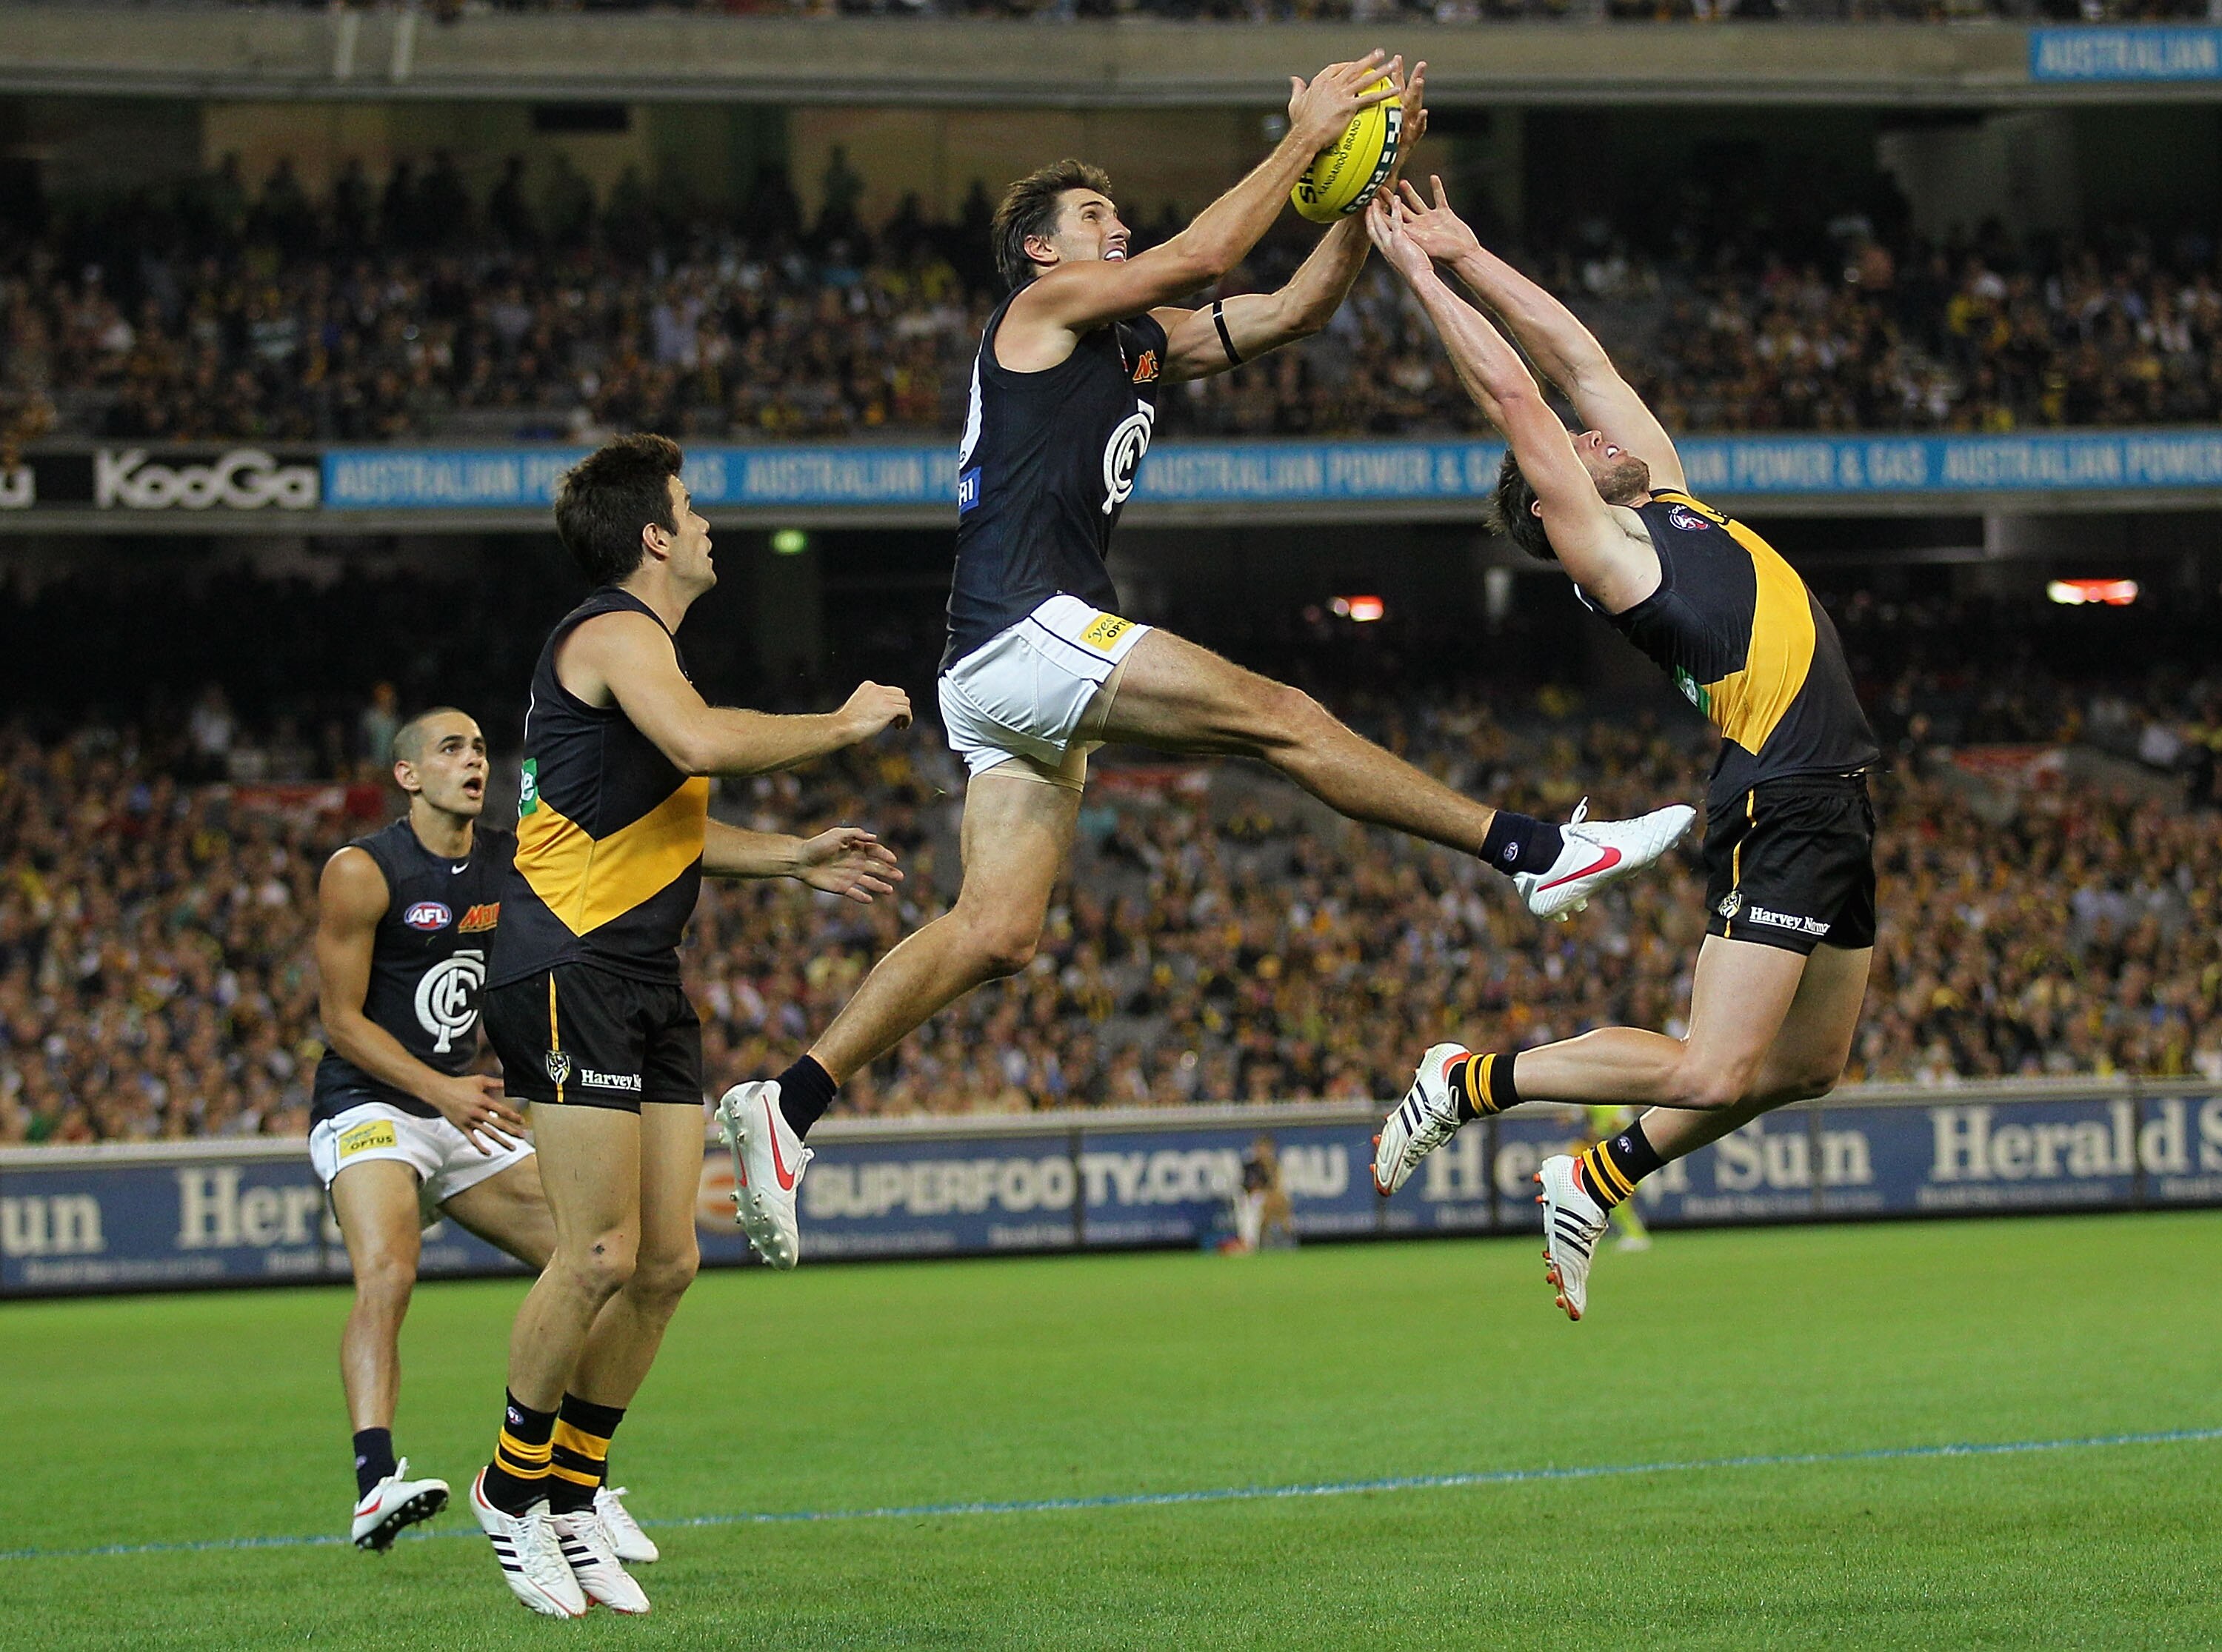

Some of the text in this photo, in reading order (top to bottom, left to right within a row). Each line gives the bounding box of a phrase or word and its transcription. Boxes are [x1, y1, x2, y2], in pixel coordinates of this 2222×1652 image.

[1344, 118, 1361, 151] BRAND
[94, 447, 318, 510] KooGa
[335, 455, 520, 498] AUSTRALIAN
[746, 453, 923, 495] AUSTRALIAN
[1145, 451, 1324, 492] AUSTRALIAN
[1330, 449, 1432, 492] POWER
[1438, 452, 1462, 489] &
[1733, 446, 1836, 486] POWER
[1867, 444, 1926, 485] GAS
[1946, 444, 2121, 485] AUSTRALIAN
[408, 909, 447, 924] AFL
[1749, 906, 1803, 930] Harvey
[581, 1069, 633, 1090] Harvey
[1713, 1115, 1875, 1192] Sun
[1927, 1098, 2189, 1183] Herald
